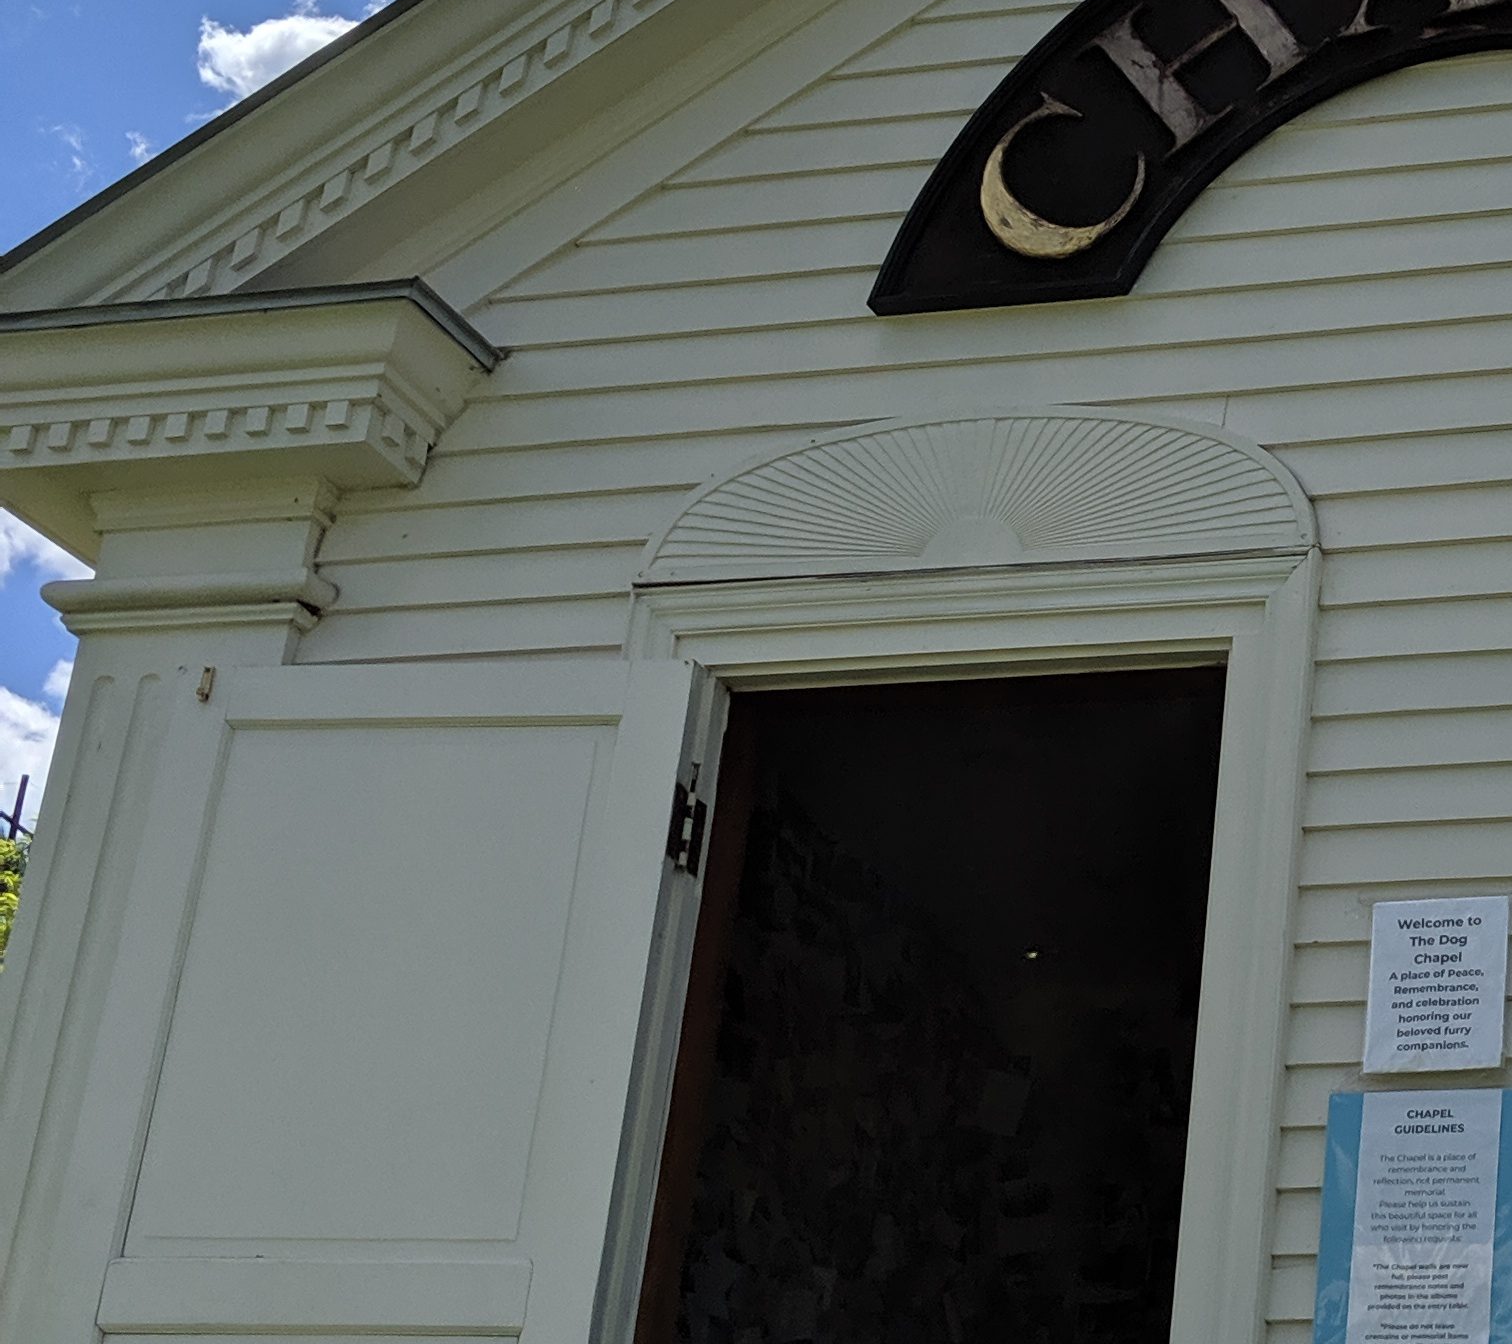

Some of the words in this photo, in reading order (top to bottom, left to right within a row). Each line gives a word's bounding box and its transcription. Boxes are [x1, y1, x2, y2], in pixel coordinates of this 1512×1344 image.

[1398, 918, 1464, 930] Welcome
[1468, 916, 1482, 926] to
[1410, 936, 1435, 946] The
[1439, 935, 1468, 947] Dog
[1414, 952, 1462, 965] Chapel
[1389, 972, 1398, 981] A
[1401, 971, 1430, 982] place
[1433, 970, 1445, 978] of
[1448, 968, 1484, 978] Peace,
[1394, 983, 1479, 995] Remembrance,
[1392, 1000, 1413, 1009] and
[1416, 997, 1479, 1007] celebration
[1398, 1011, 1449, 1023] honoring
[1453, 1012, 1472, 1020] our
[1397, 1027, 1441, 1038] beloved
[1444, 1026, 1472, 1036] furry
[1397, 1041, 1469, 1052] companions.
[1407, 1109, 1454, 1119] CHAPEL
[1394, 1123, 1464, 1134] GUIDELINES
[1397, 1154, 1426, 1162] Chapel
[1432, 1177, 1480, 1185] permanent
[1409, 1224, 1420, 1232] by
